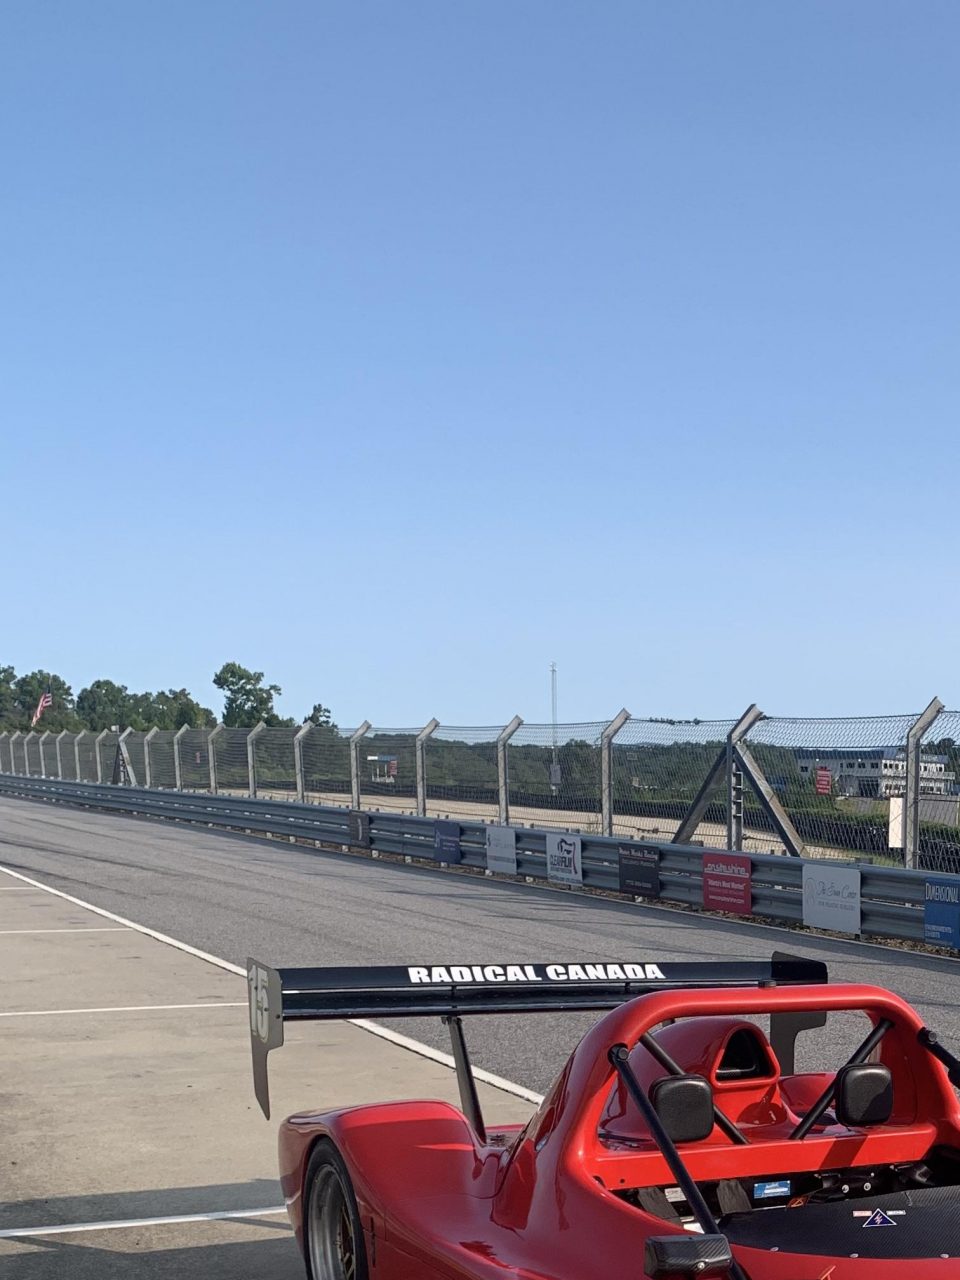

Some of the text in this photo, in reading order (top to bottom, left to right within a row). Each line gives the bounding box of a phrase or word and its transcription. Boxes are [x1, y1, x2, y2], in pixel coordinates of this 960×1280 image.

[407, 963, 666, 983] RADICAL CANADA
[248, 964, 269, 1044] 15
